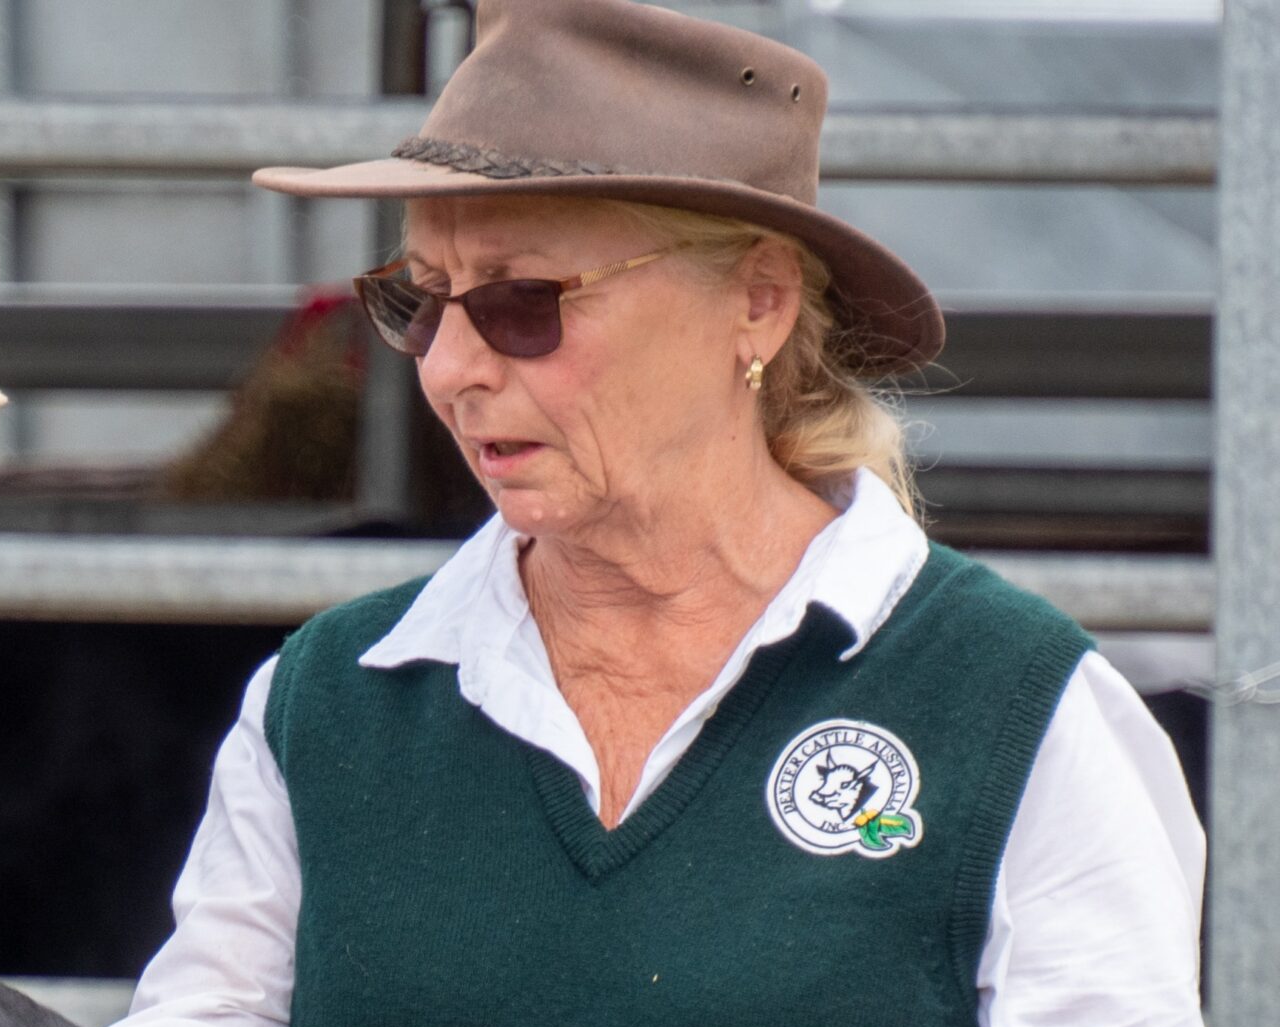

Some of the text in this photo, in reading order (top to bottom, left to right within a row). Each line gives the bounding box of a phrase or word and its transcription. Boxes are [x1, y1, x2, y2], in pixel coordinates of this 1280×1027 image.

[779, 731, 907, 815] DEXTER CATTLE AUSTRALIA
